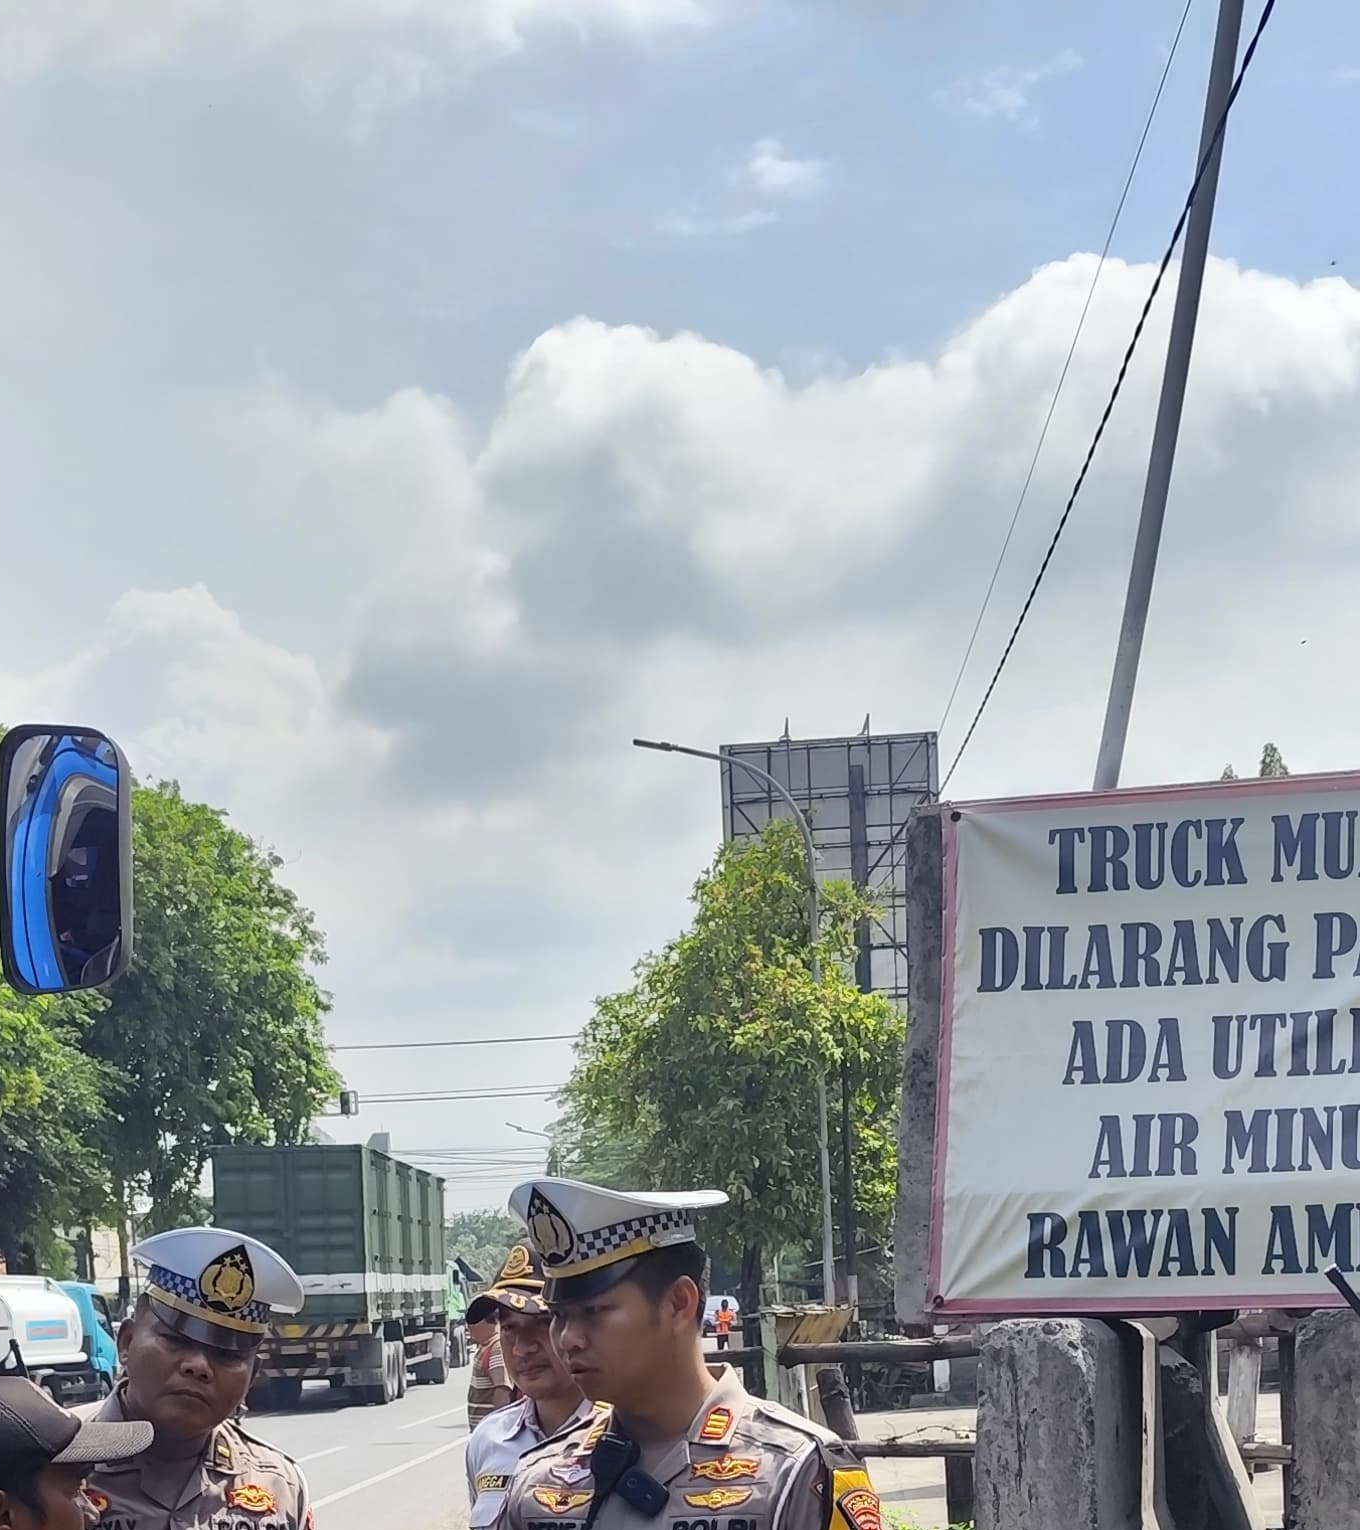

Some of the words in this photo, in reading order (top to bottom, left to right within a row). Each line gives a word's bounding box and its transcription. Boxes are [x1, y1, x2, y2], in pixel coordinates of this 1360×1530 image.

[1048, 818, 1247, 895] TRUCK
[977, 914, 1290, 993] DILARANG
[1062, 1017, 1187, 1086] ADA
[1088, 1112, 1199, 1180] AIR
[1024, 1205, 1240, 1279] RAWAN
